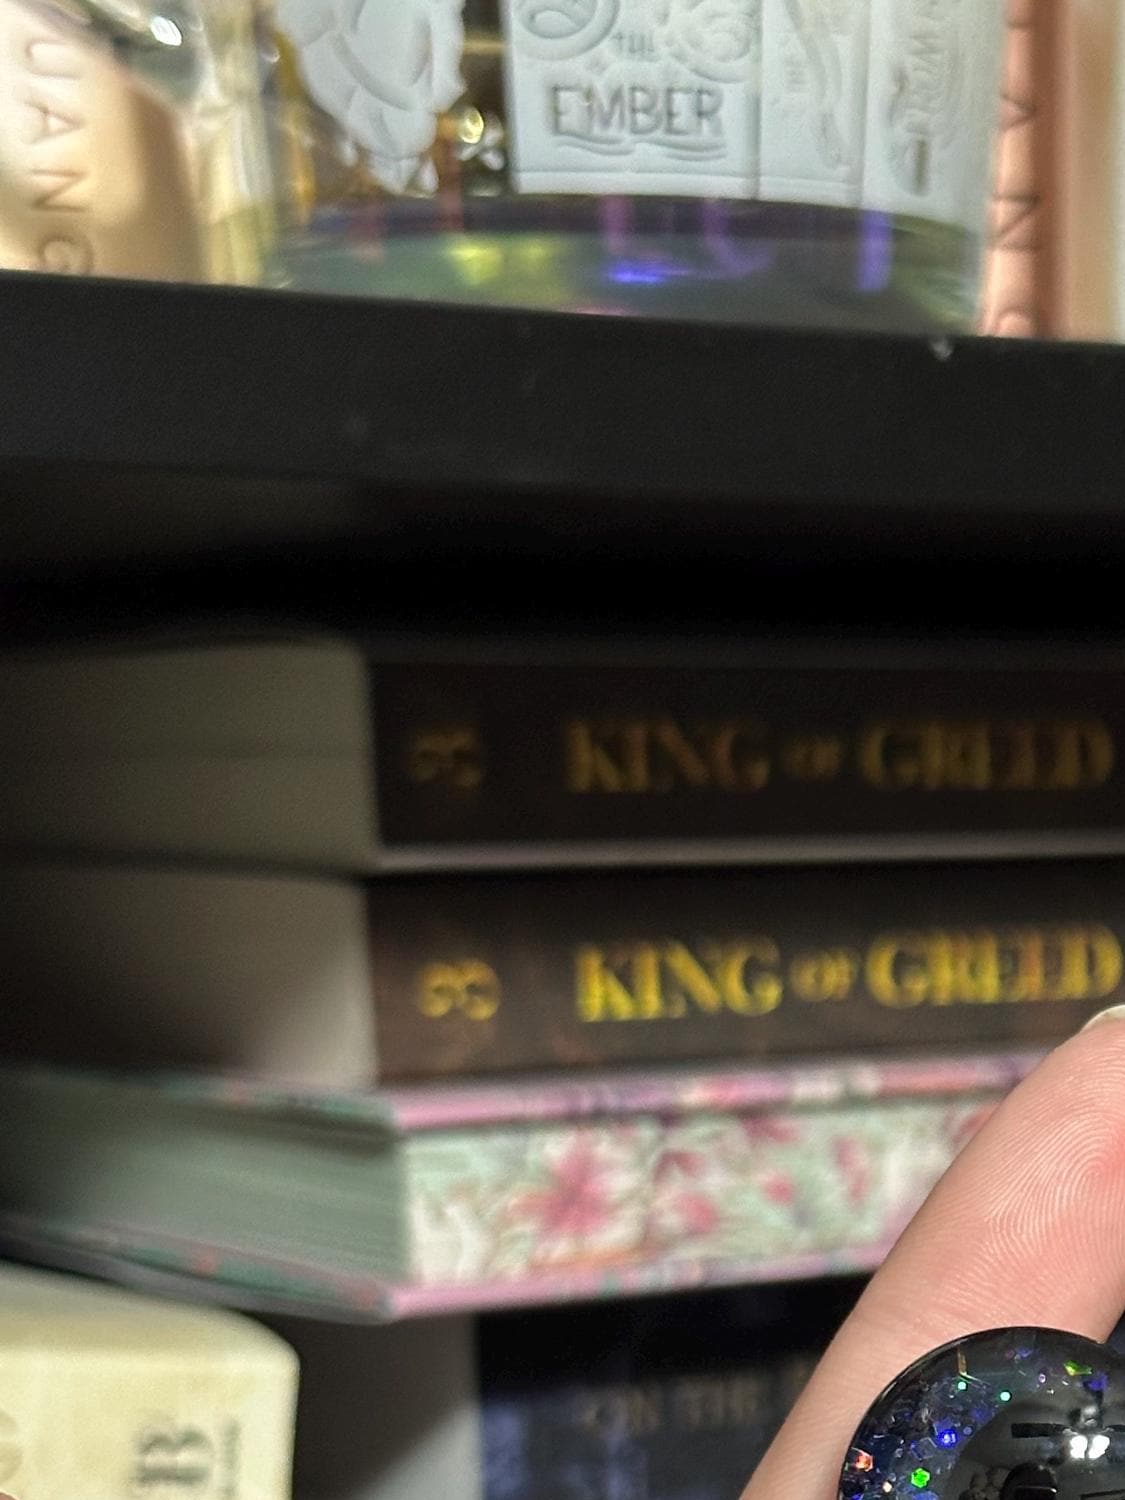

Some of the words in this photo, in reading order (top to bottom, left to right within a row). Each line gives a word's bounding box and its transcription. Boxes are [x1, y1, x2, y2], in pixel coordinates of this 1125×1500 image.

[550, 80, 726, 138] EMBER
[563, 716, 772, 792] KING
[860, 714, 1118, 792] GREED
[574, 932, 785, 1023] KING
[865, 928, 1125, 1010] GREED
